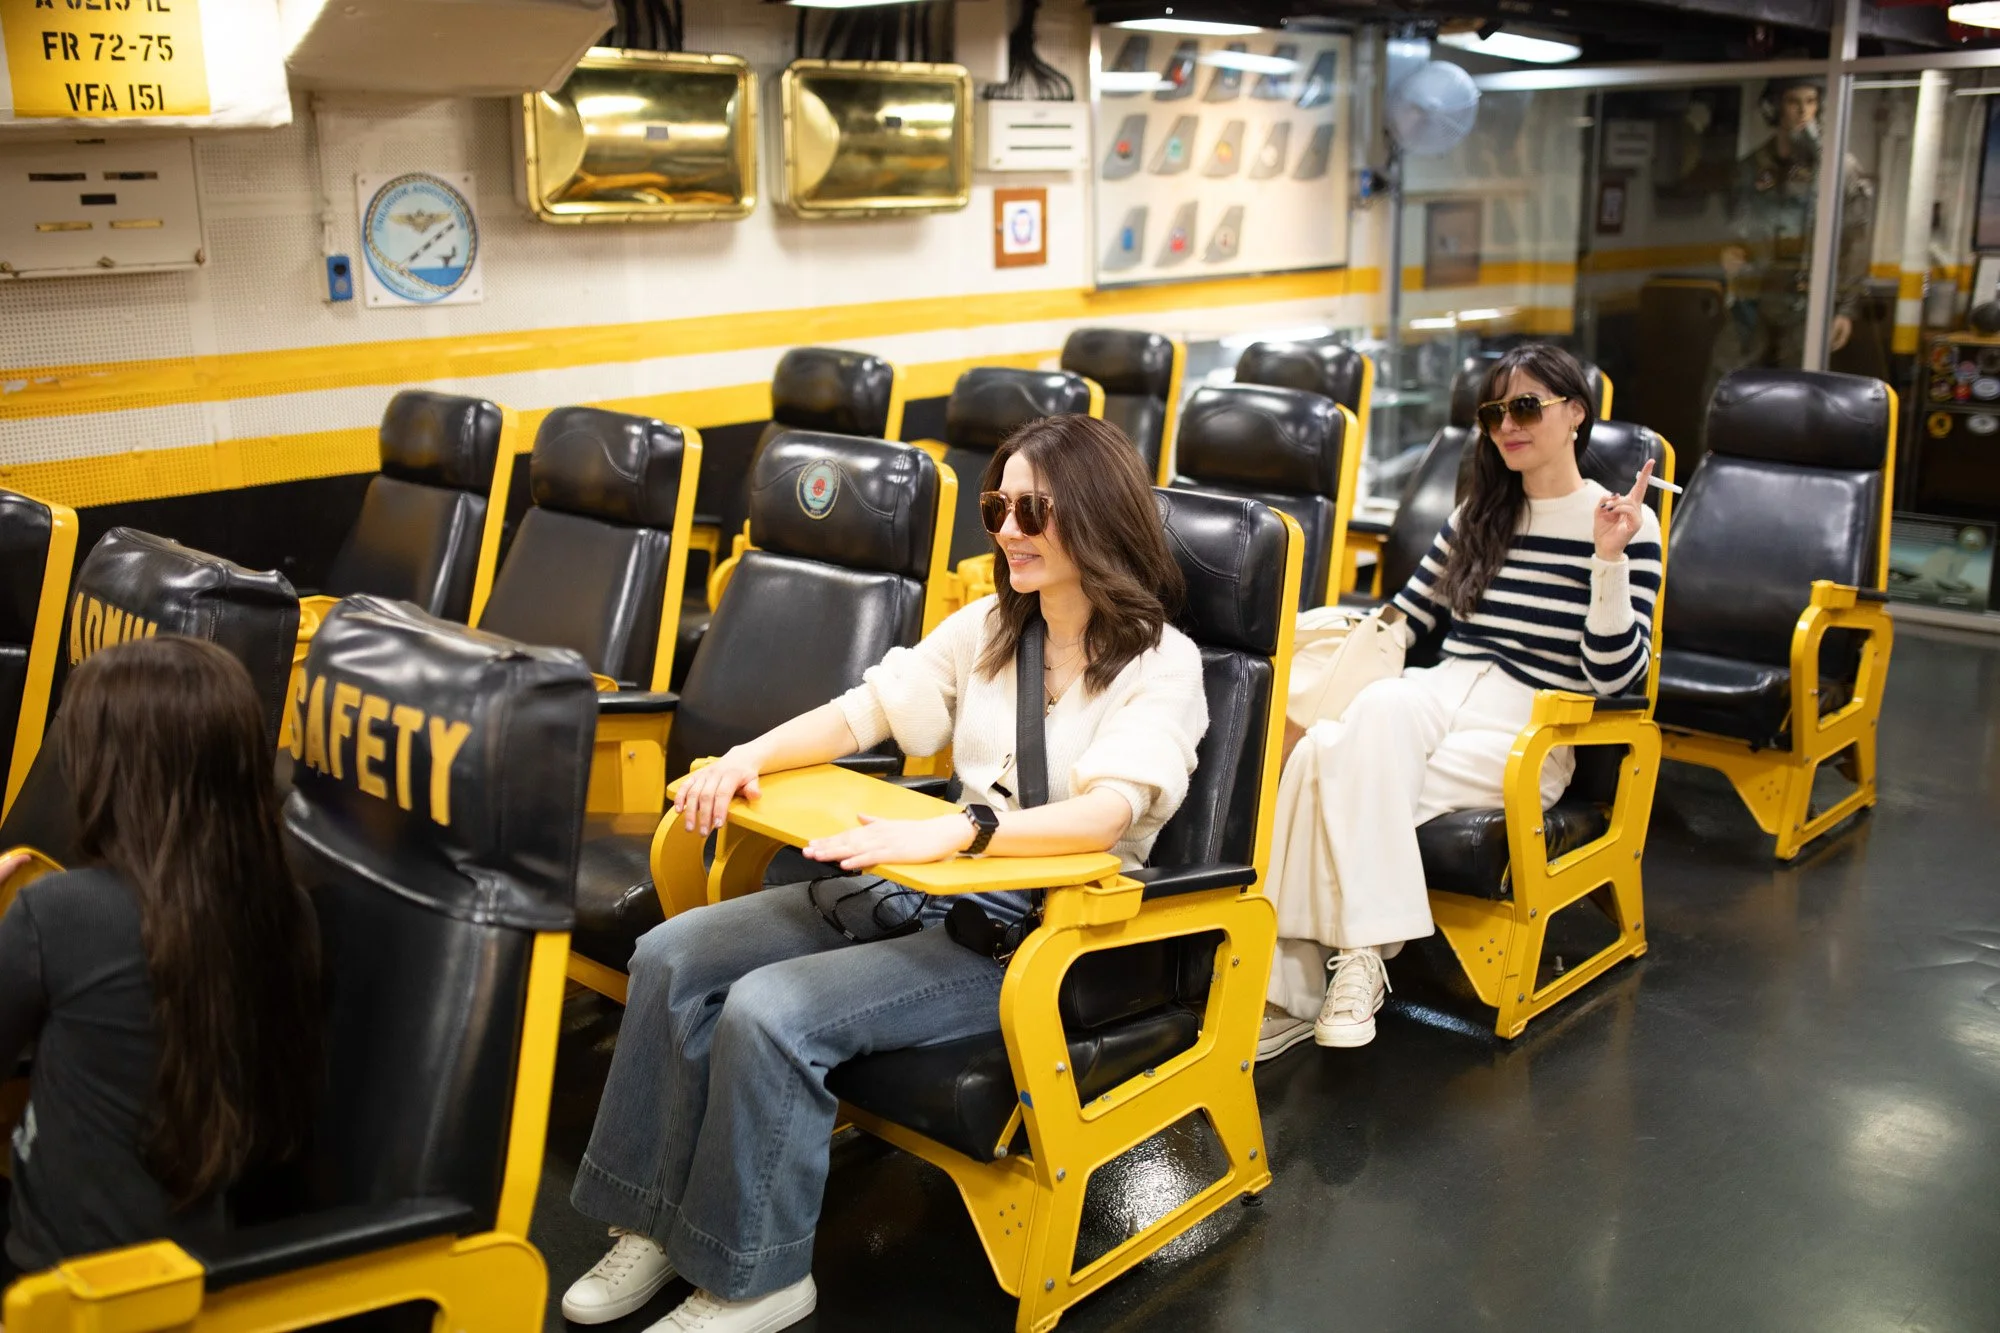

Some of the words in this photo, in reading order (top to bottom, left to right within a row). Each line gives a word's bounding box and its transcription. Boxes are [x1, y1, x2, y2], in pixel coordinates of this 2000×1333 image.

[42, 31, 80, 61] FR
[90, 32, 173, 61] 72-75
[65, 83, 118, 111] VFA
[128, 84, 165, 111] 151
[70, 592, 158, 665] ADM
[289, 667, 472, 826] SAFETY
